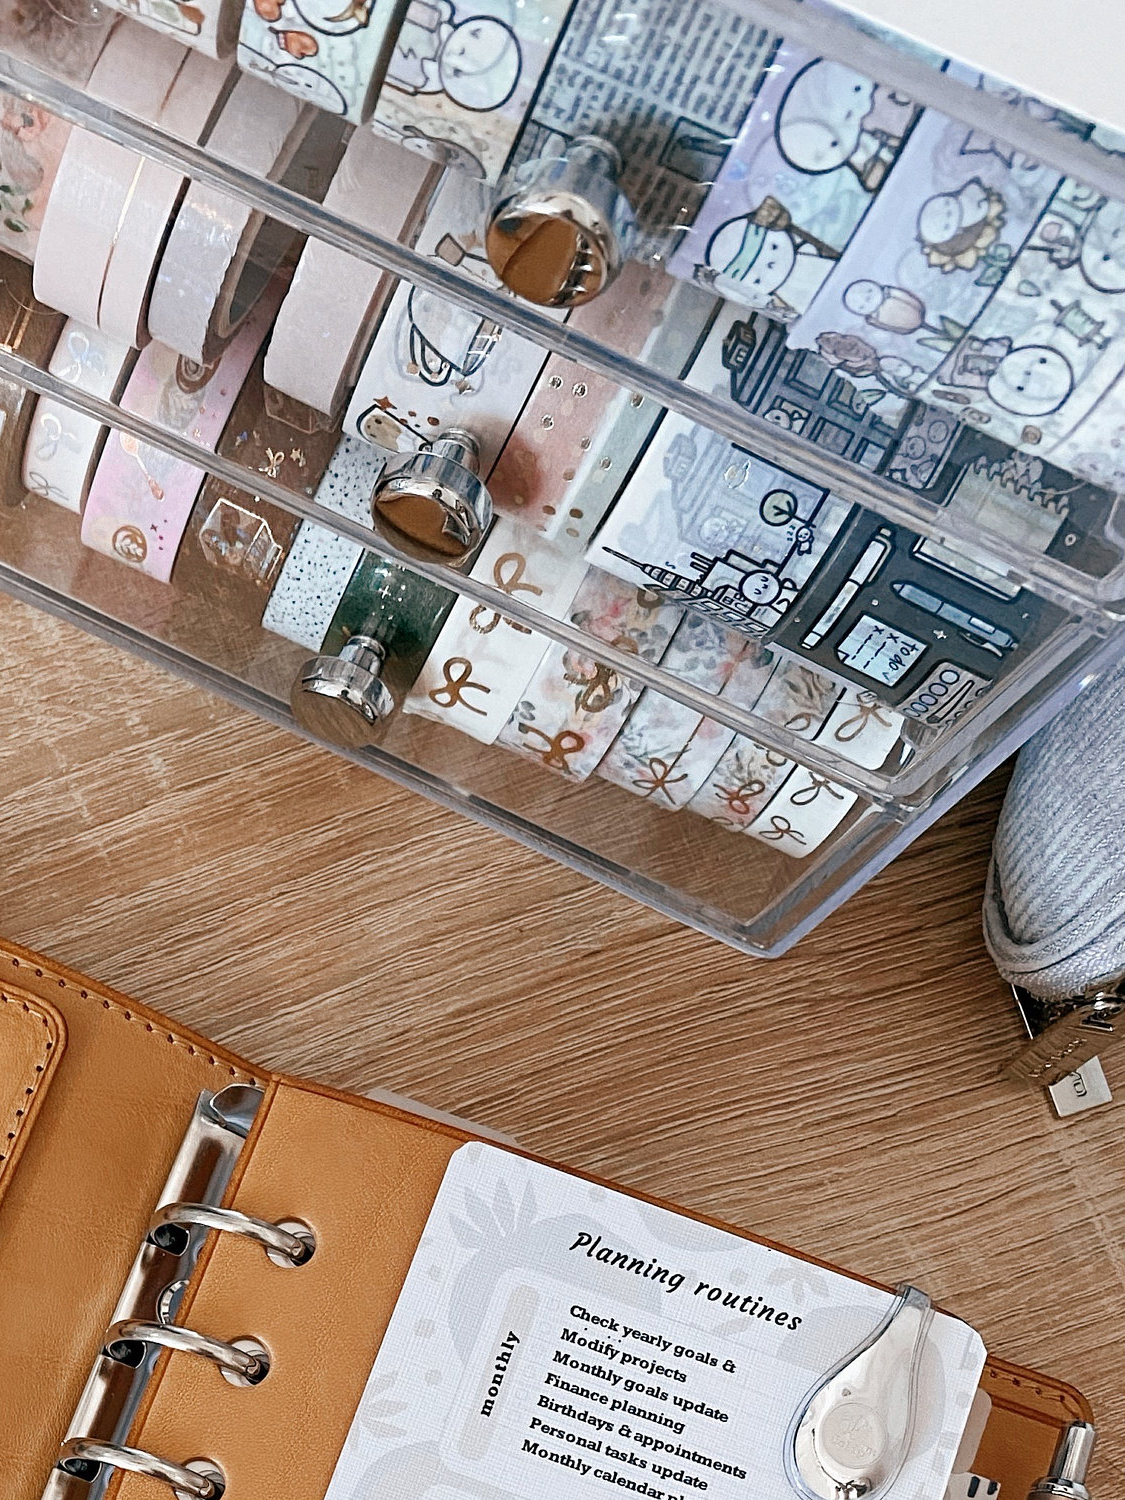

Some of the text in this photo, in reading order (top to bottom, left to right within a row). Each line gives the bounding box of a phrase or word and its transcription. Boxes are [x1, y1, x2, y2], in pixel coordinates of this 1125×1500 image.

[569, 1232, 803, 1331] Planning routines
[481, 1331, 520, 1417] monthly
[560, 1328, 688, 1383] Modify projects
[570, 1305, 737, 1374] Check yearly goals &
[544, 1372, 686, 1435] Finance planning
[552, 1350, 729, 1423] Monthly goals update
[521, 1439, 593, 1476] Monthly
[594, 1469, 666, 1500] calendar
[529, 1417, 709, 1491] Personal tasks update
[537, 1395, 748, 1480] Birthdays & appointments
